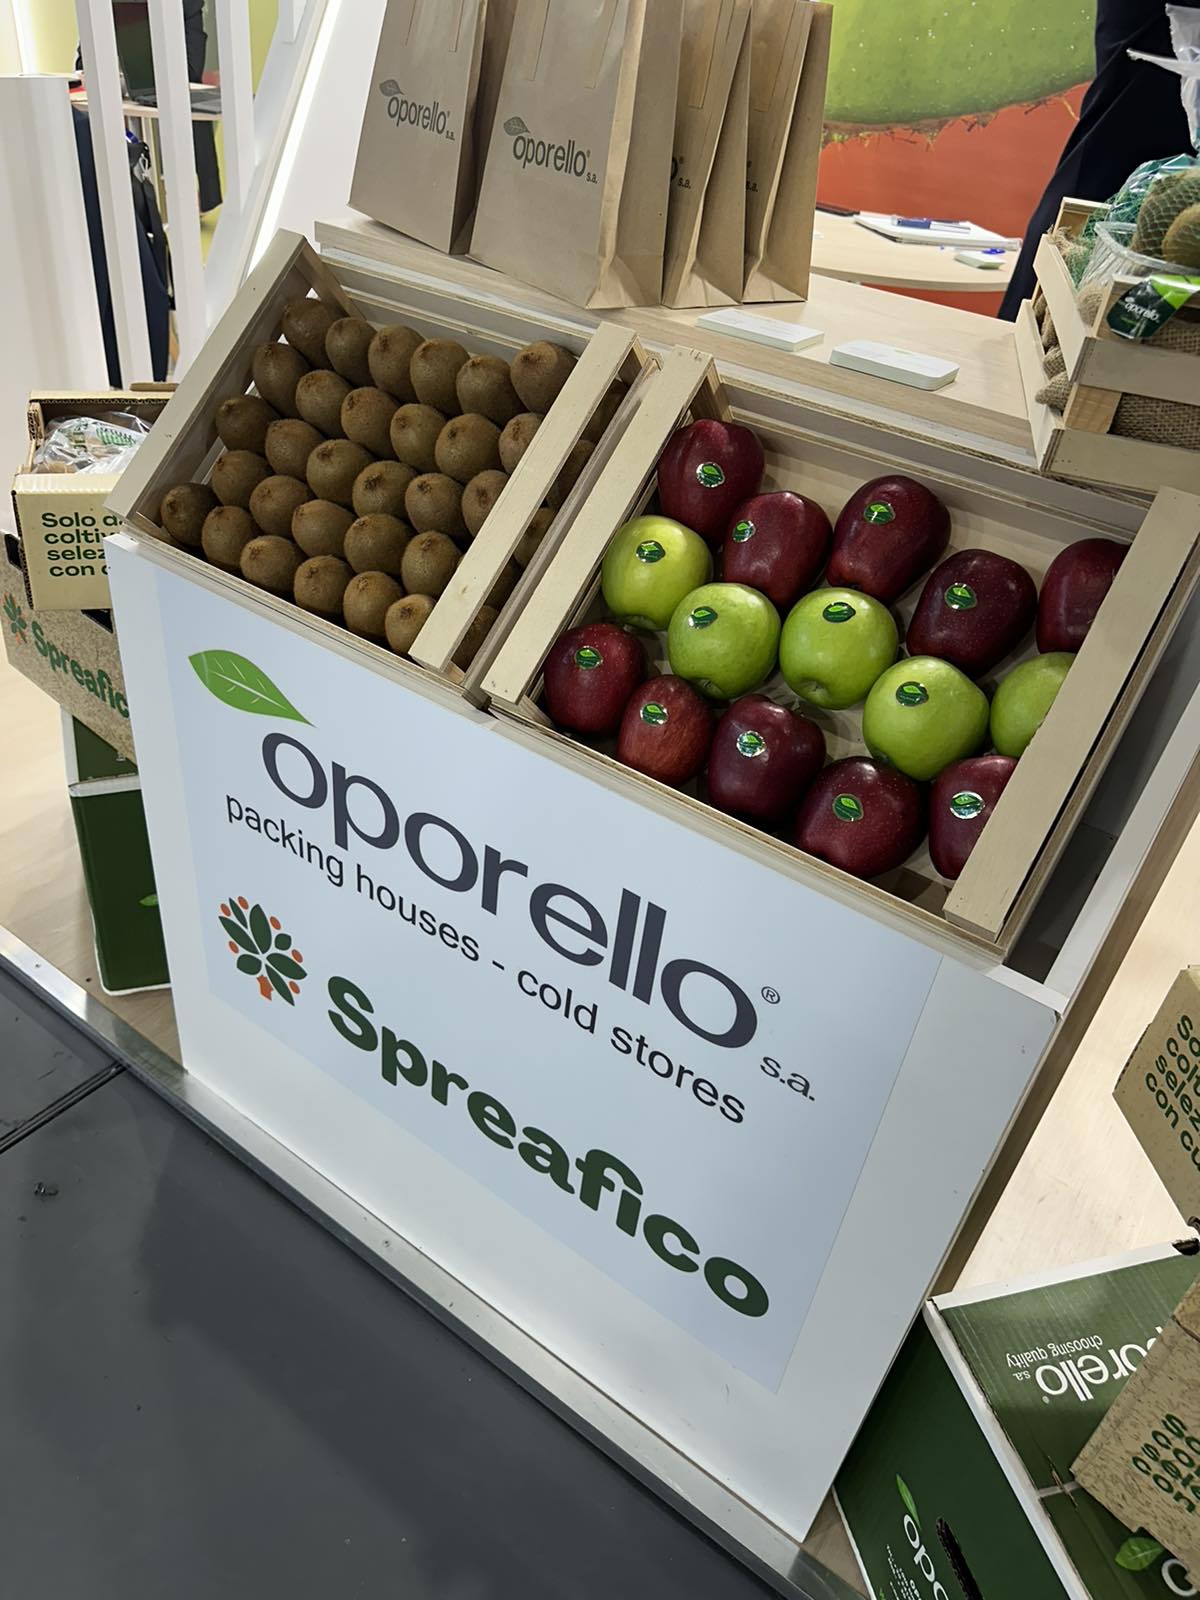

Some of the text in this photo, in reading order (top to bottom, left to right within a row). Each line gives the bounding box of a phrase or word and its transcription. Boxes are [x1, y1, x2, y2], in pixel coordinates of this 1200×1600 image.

[387, 97, 447, 135] oporello
[513, 135, 599, 184] oporello s.a.
[41, 511, 96, 528] Solo
[49, 565, 95, 577] con
[226, 794, 345, 888] packing
[356, 863, 480, 963] houses
[517, 970, 600, 1036] cold
[610, 1026, 745, 1124] stores
[759, 1055, 816, 1102] s.a.
[1145, 1072, 1179, 1129] con
[327, 974, 771, 1319] Spreafico
[1006, 1334, 1103, 1369] choosing quality
[1035, 1326, 1163, 1401] orello
[1132, 1456, 1197, 1514] con
